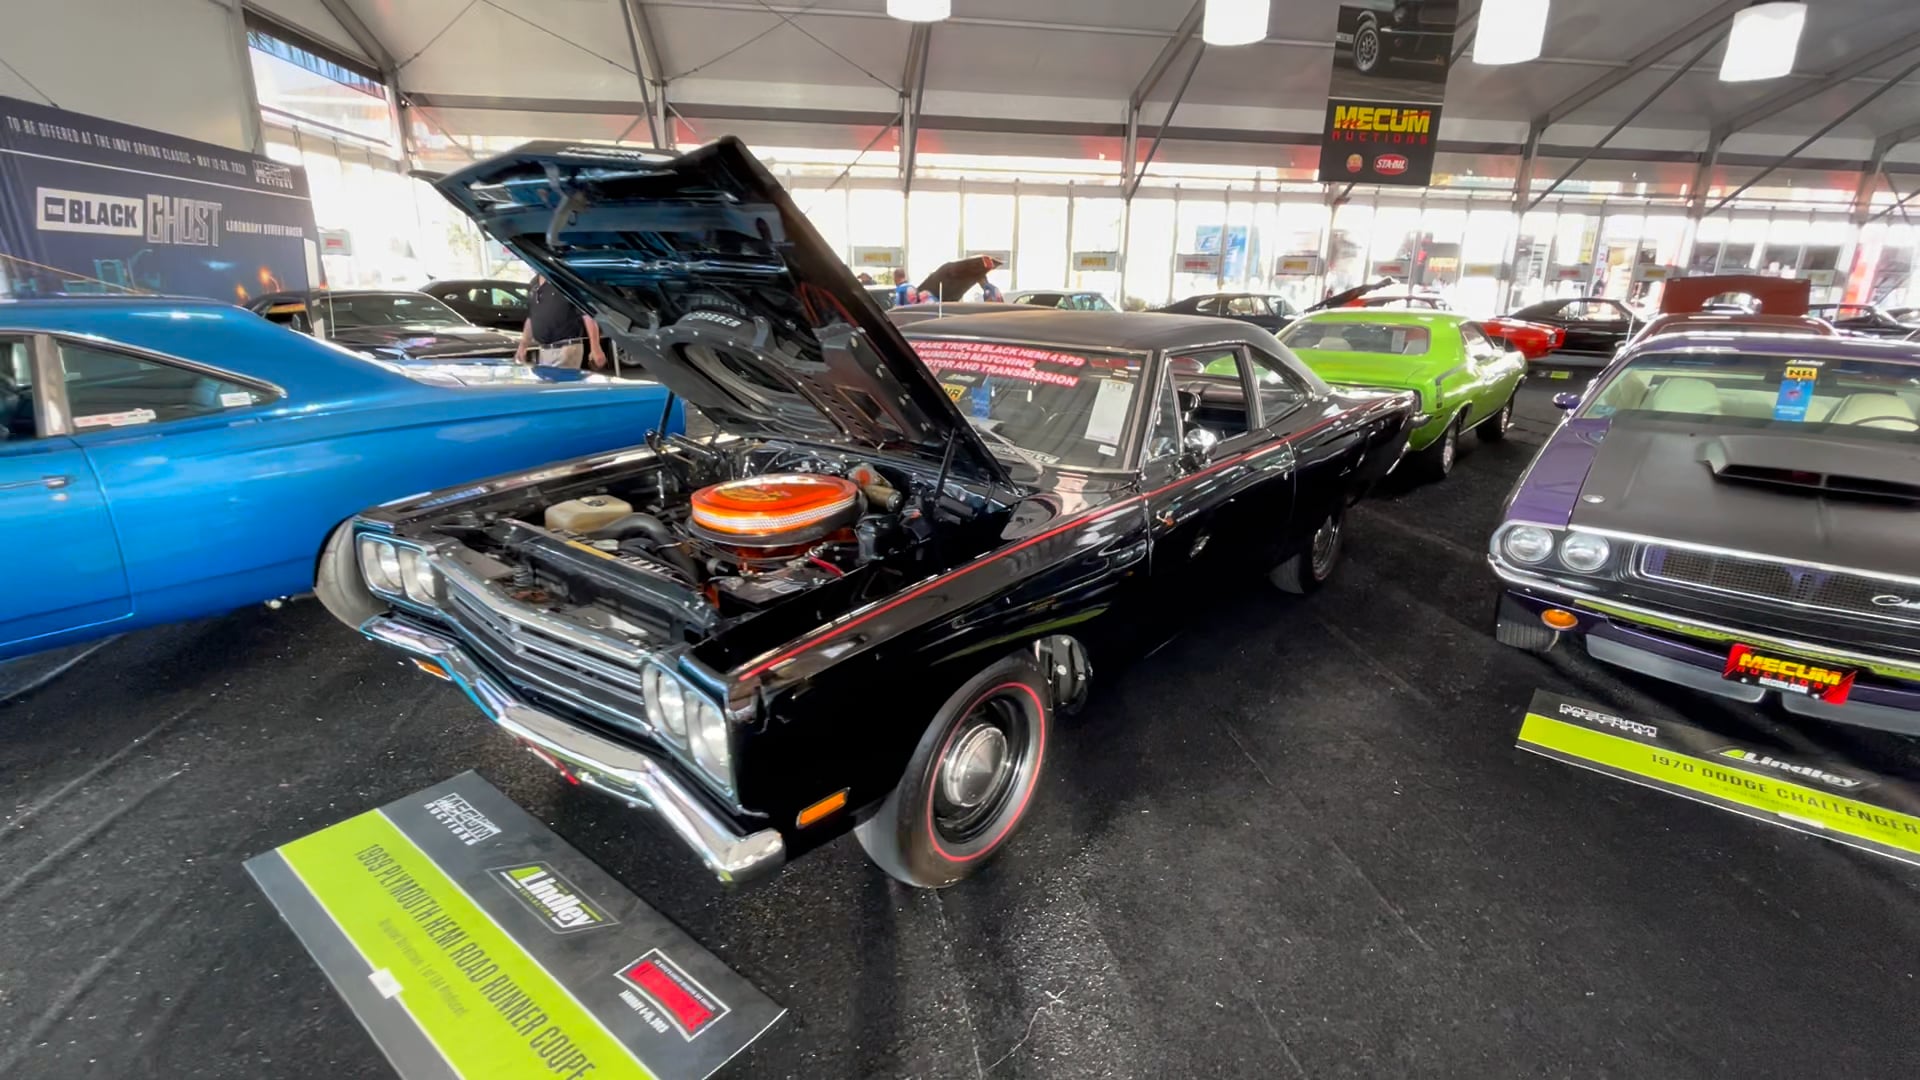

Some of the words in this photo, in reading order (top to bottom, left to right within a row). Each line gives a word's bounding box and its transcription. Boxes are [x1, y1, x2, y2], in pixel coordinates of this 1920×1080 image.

[1332, 131, 1428, 144] AUCTIONS
[1334, 105, 1431, 133] MECUM
[6, 115, 20, 132] TO
[23, 119, 36, 135] BE
[38, 122, 80, 144] OFFERED
[81, 131, 93, 145] AT
[94, 133, 111, 149] THE
[112, 137, 132, 153] INDY
[162, 147, 191, 165] CLASSIC
[69, 199, 137, 228] BLACK
[147, 193, 223, 247] GHOST
[944, 341, 982, 352] TRIPLE
[981, 343, 1017, 356] BLACK
[1018, 347, 1049, 361] HEMI
[1050, 353, 1059, 362] 4
[1060, 354, 1085, 367] SPD
[970, 352, 1036, 368] MATCHING
[954, 360, 980, 371] AND
[981, 363, 1079, 387] TRANSMISSION
[1789, 369, 1813, 377] NR
[1739, 653, 1842, 686] MECUM
[1559, 703, 1657, 734] MECUM
[1744, 752, 1862, 788] Lindley
[1651, 753, 1694, 773] 1970
[1702, 767, 1769, 794] DODGE
[1776, 787, 1920, 835] CHALLENGER
[423, 802, 478, 846] AUCTIONS
[433, 792, 502, 841] MECUM
[354, 844, 395, 872] 1969
[374, 864, 443, 922] PLYMOUTH
[517, 870, 597, 928] Lindley
[422, 914, 470, 951] HEMI
[448, 942, 499, 982] ROAD
[479, 974, 549, 1037] RUNNER
[529, 1026, 596, 1080] COUPE
